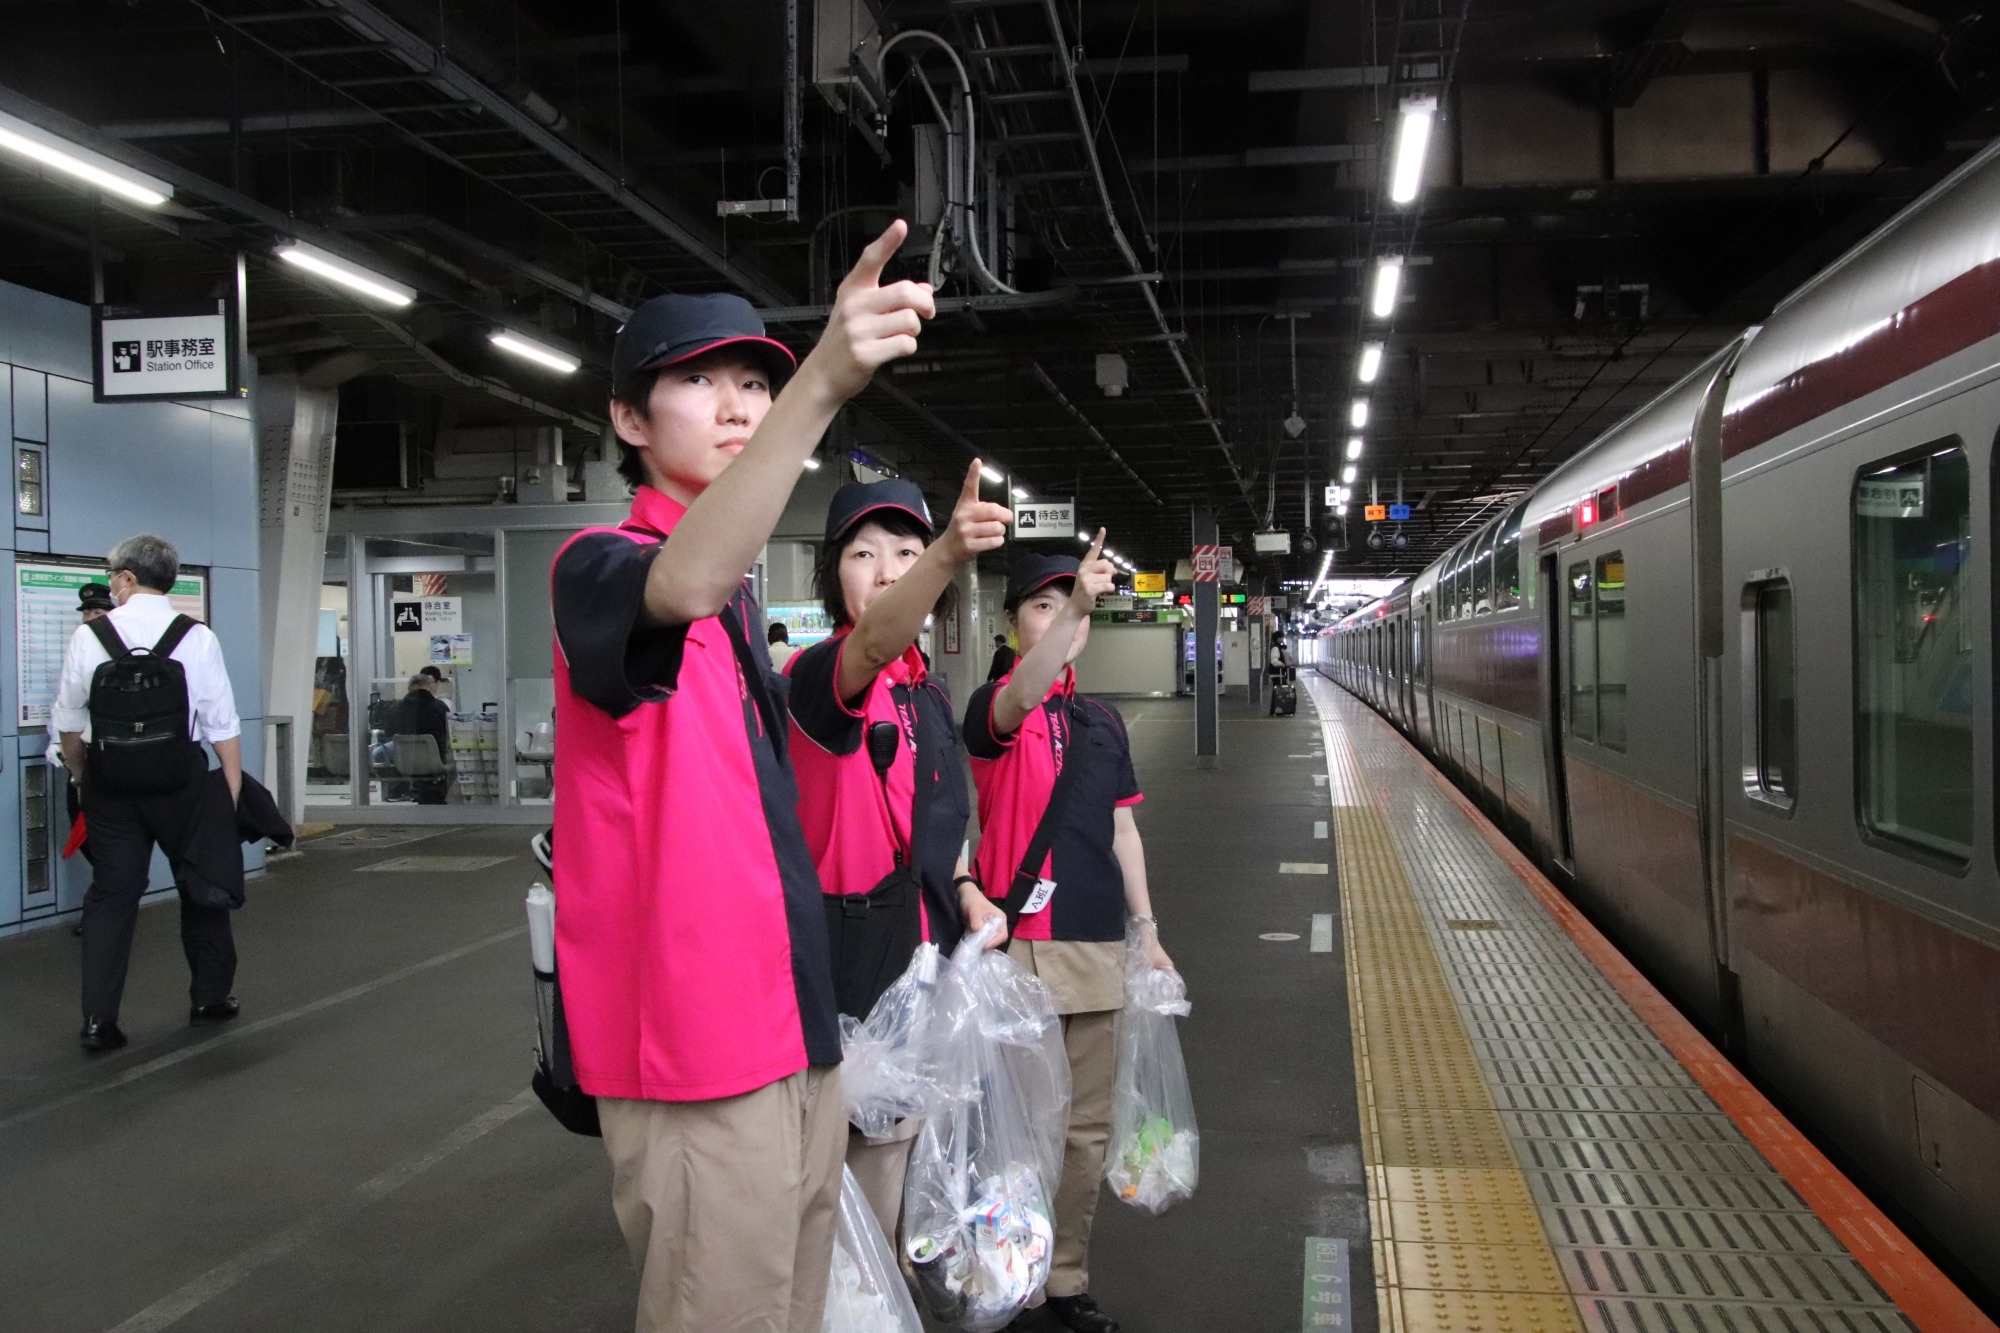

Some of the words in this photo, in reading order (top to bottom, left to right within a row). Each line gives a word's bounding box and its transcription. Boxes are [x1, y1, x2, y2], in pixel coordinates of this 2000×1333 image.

[146, 338, 215, 358] 駅事務室
[146, 361, 182, 372] Station
[185, 359, 214, 370] Office
[1038, 509, 1070, 521] 待合室
[424, 601, 451, 611] 待合室
[1118, 611, 1151, 619] KIOSK
[898, 703, 915, 738] TEAM
[1048, 712, 1063, 742] TEAM
[1310, 1273, 1344, 1328] 6号車
